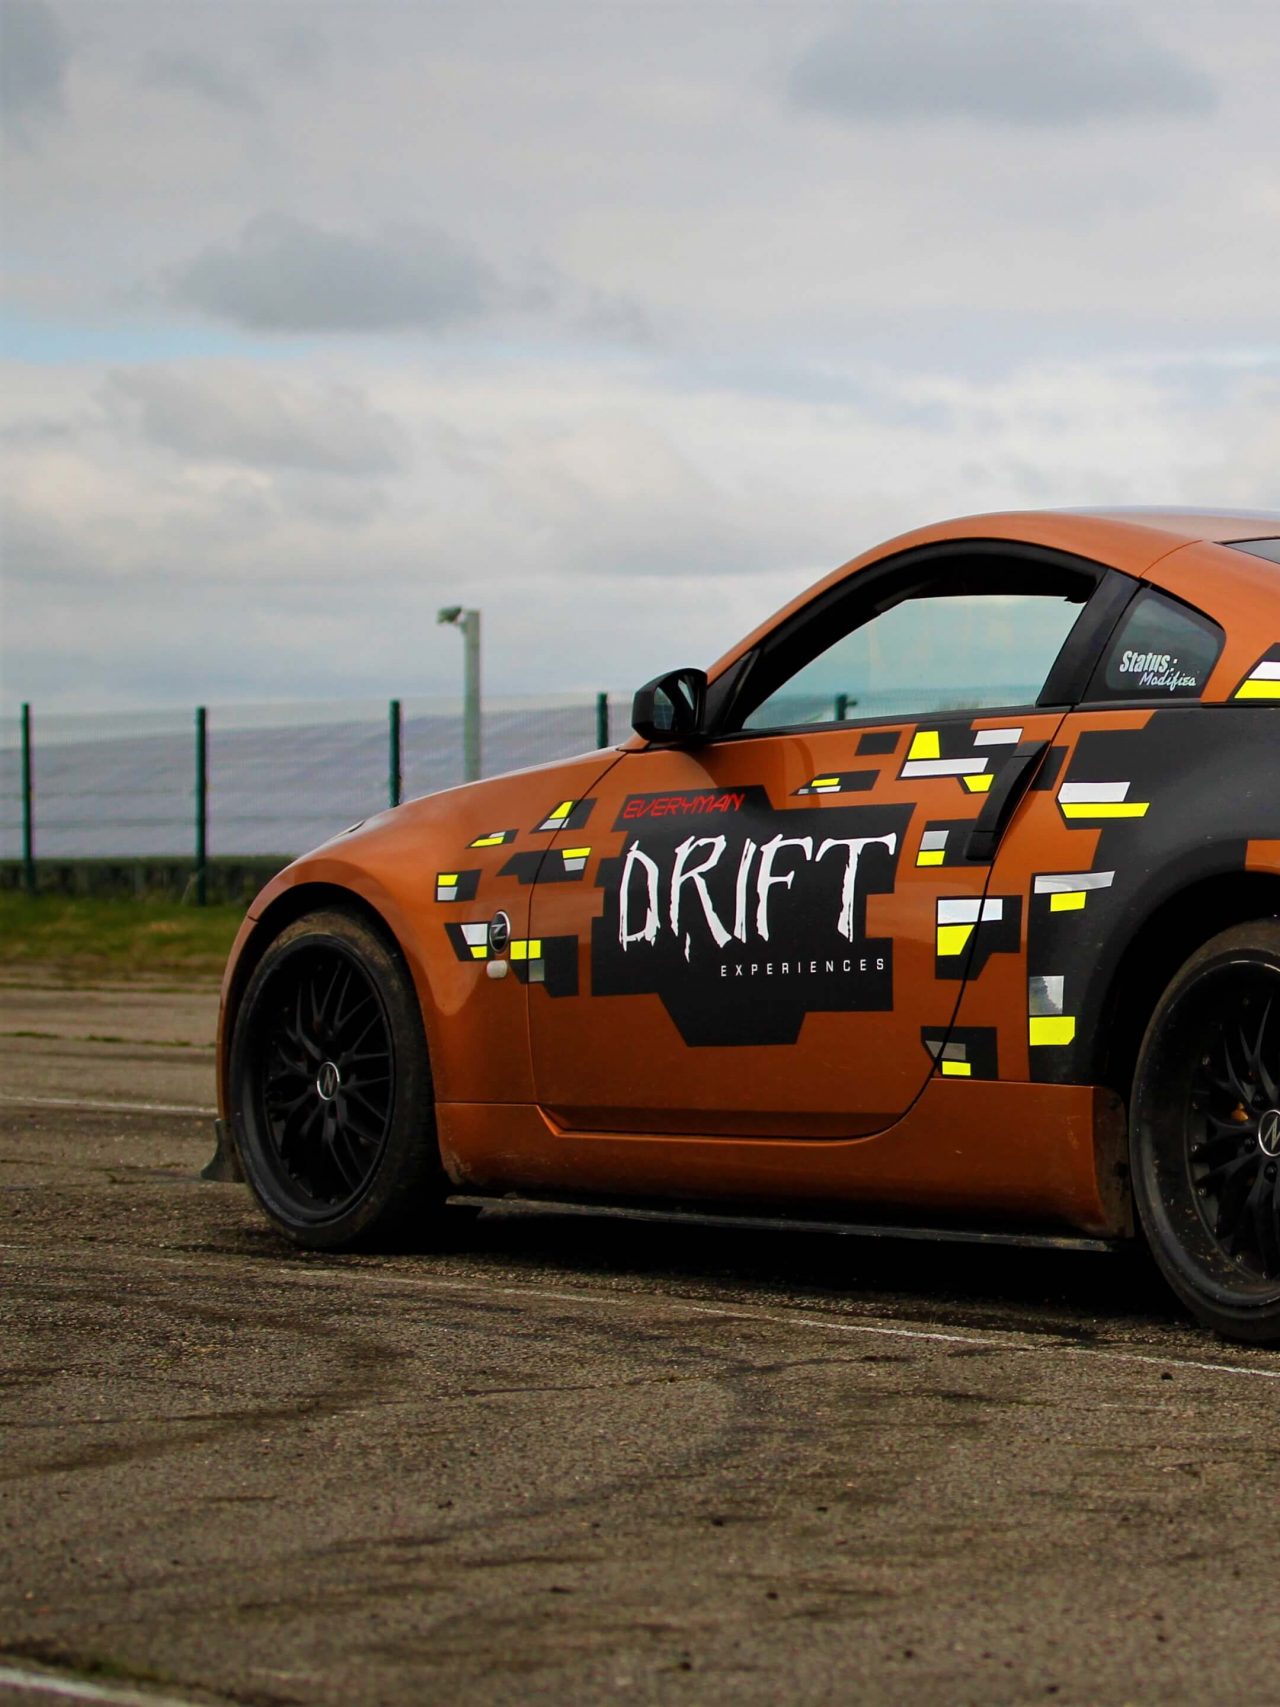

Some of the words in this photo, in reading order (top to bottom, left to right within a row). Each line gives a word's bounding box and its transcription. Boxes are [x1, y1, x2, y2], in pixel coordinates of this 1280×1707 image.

[623, 793, 746, 819] EVERYMAN
[619, 832, 897, 963] DRIFT
[720, 958, 885, 977] EXPERIENCES
